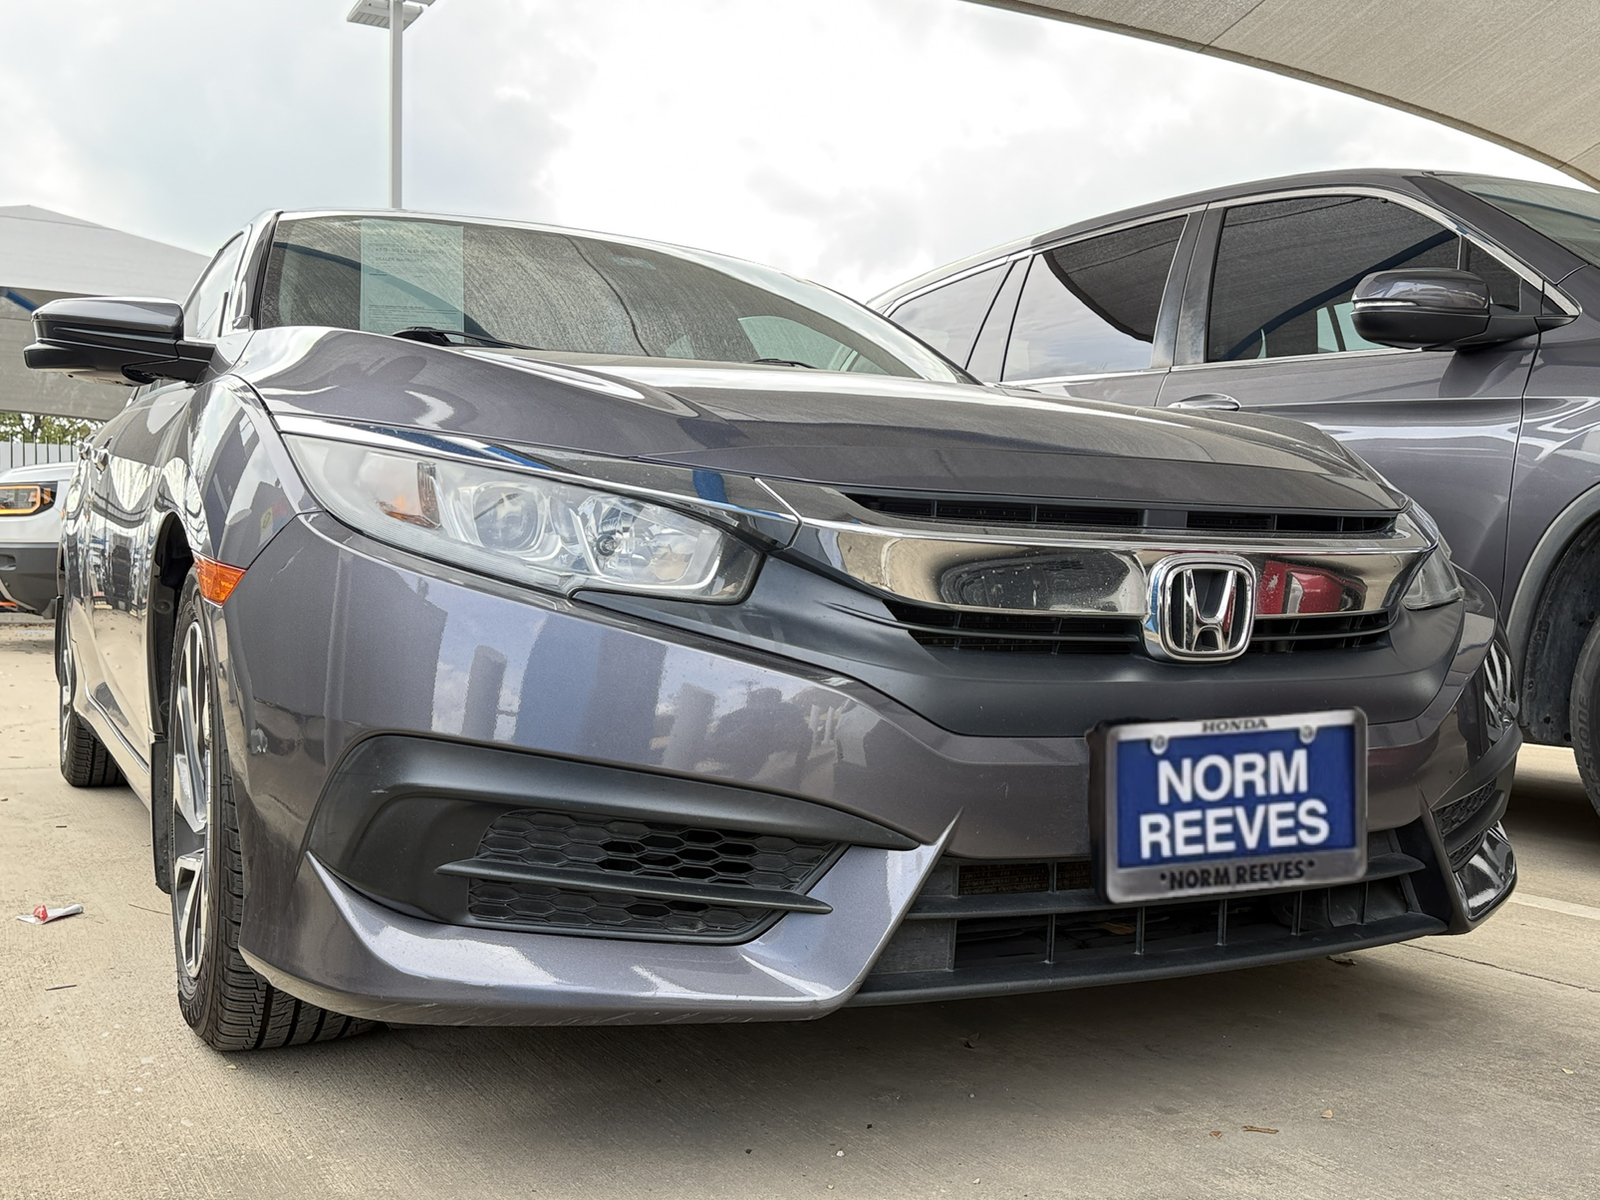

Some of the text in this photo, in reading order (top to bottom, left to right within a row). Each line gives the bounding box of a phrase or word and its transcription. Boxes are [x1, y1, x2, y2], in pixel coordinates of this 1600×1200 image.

[1201, 718, 1268, 733] HONDA
[1158, 748, 1308, 805] NORM
[1139, 799, 1330, 860] REEVES
[1170, 860, 1305, 890] NORM REEVES
